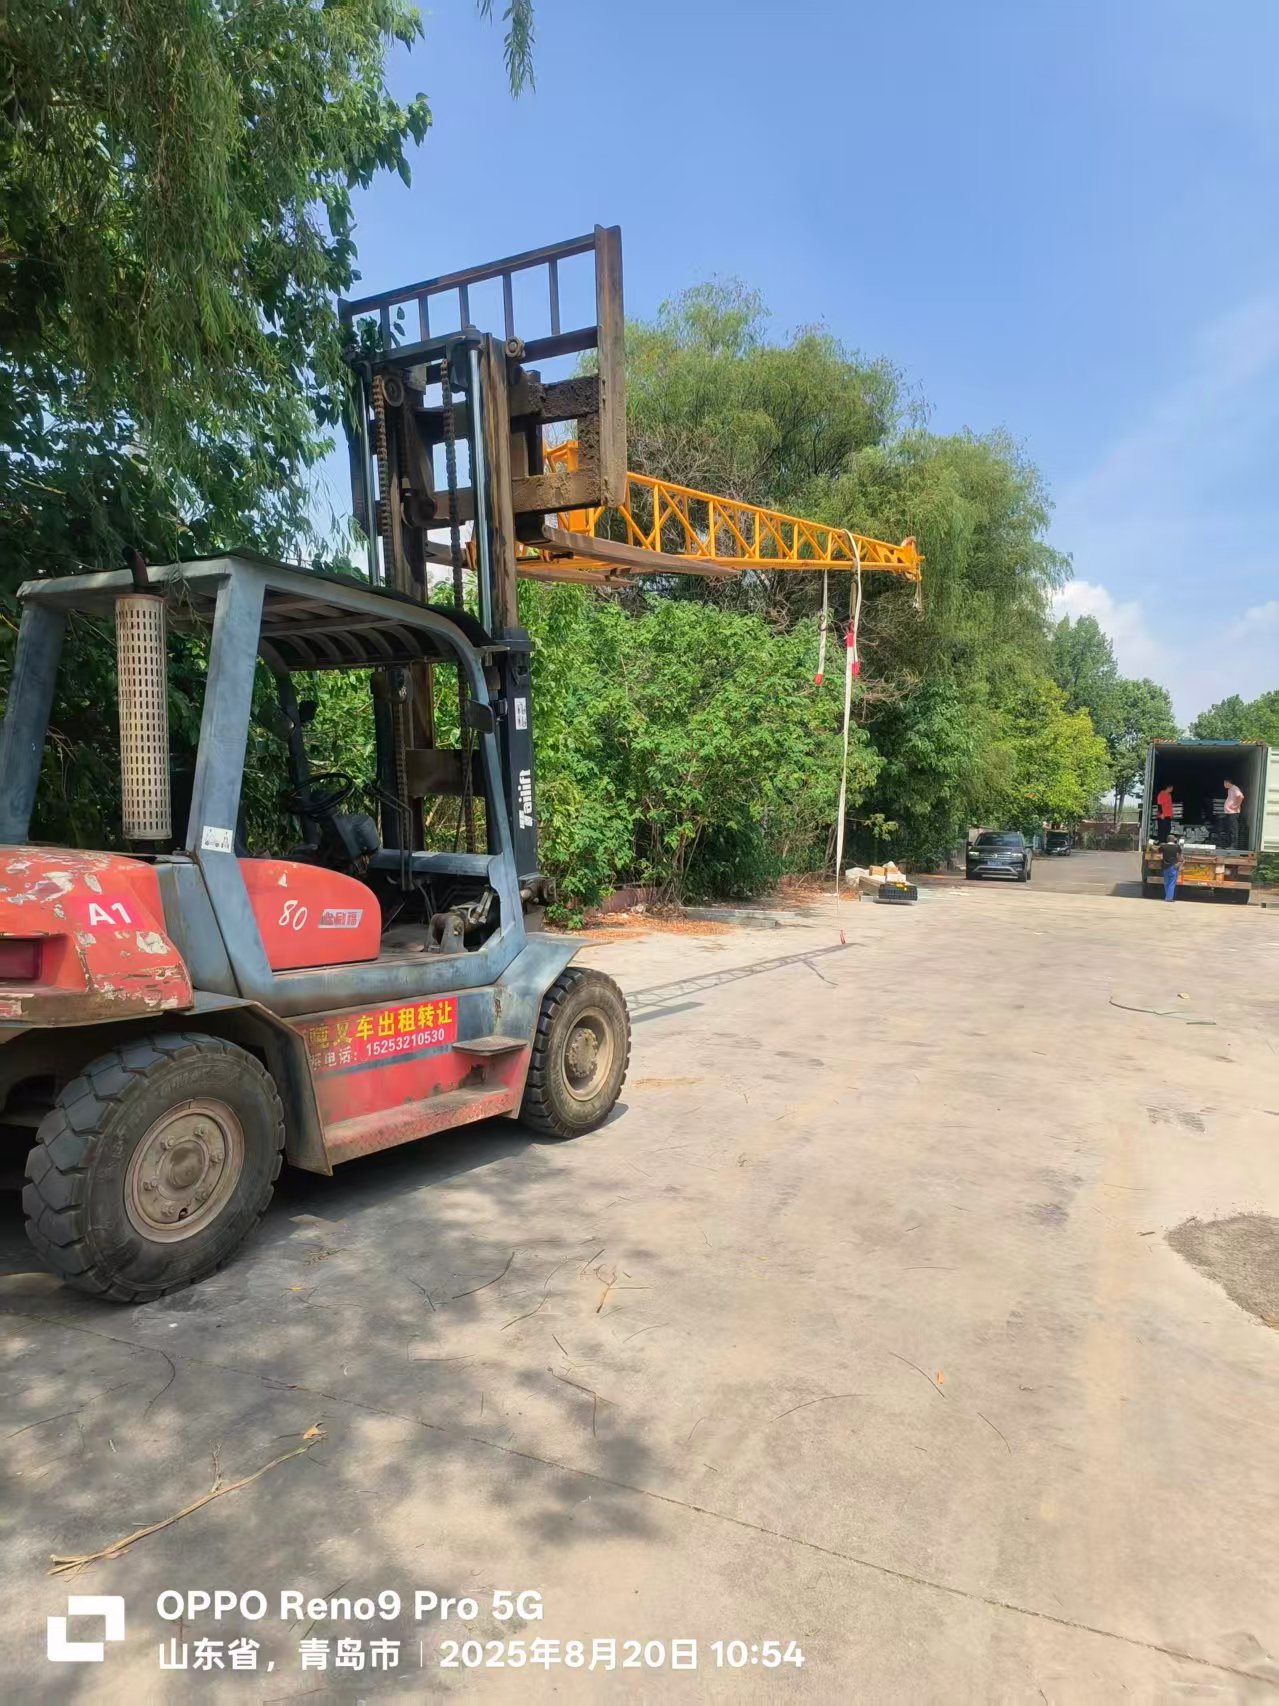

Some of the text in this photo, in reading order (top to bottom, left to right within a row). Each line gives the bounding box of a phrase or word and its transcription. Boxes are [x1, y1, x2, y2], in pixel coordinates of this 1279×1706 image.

[518, 769, 533, 829] Tailift
[88, 902, 132, 926] A1
[278, 900, 308, 931] 80
[366, 1028, 445, 1057] 15253210530
